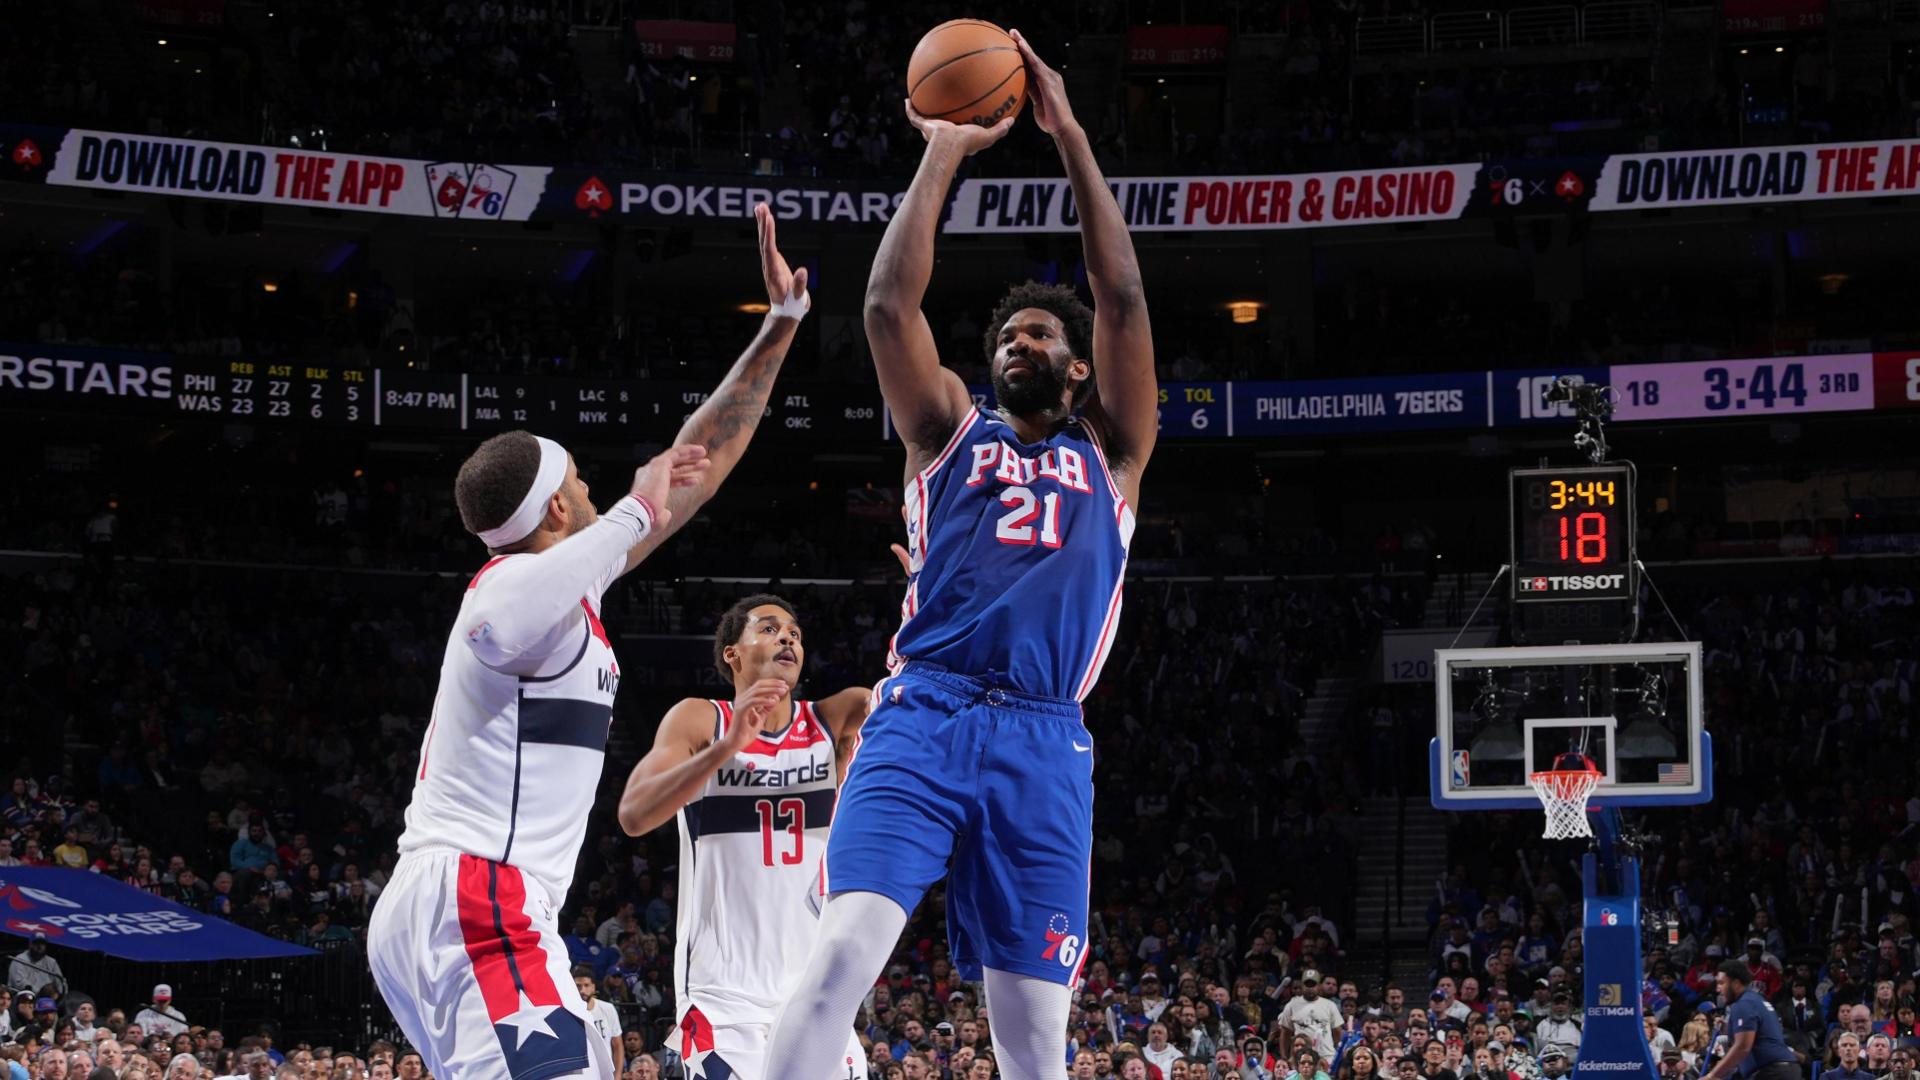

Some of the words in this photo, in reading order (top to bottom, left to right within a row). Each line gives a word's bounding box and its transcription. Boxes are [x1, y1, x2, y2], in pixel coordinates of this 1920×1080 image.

[76, 136, 266, 195] DOWNLOAD
[275, 153, 335, 201] THE
[337, 160, 404, 207] APP
[1617, 150, 1807, 204] DOWNLOAD
[1817, 146, 1878, 193] THE
[467, 184, 503, 216] 76
[976, 184, 1057, 227] PLAY
[1184, 180, 1293, 225] POKER
[1299, 178, 1325, 222] &
[1333, 171, 1455, 220] CASINO
[230, 361, 254, 375] REB
[267, 364, 293, 378] AST
[305, 367, 329, 380] BLK
[342, 370, 366, 383] STL
[184, 374, 216, 392] PHI
[231, 378, 254, 394] 27
[268, 380, 292, 396] 27
[310, 383, 323, 399] 2
[347, 386, 359, 401] 5
[475, 385, 499, 399] LAL
[515, 387, 525, 399] 9
[579, 389, 606, 402] LAC
[619, 391, 629, 402] 8
[1184, 387, 1216, 403] TOL
[1627, 380, 1660, 407] 18
[1704, 364, 1807, 411] 3:44
[1820, 373, 1860, 394] 3RD
[177, 394, 222, 412] WAS
[230, 398, 254, 414] 23
[268, 400, 292, 416] 23
[310, 403, 323, 419] 6
[347, 405, 359, 421] 3
[385, 389, 423, 407] 8:47
[426, 391, 456, 409] PM
[784, 395, 810, 408] ATL
[1256, 392, 1387, 421] PHILADELPHIA
[1394, 389, 1464, 415] 76ERS
[475, 407, 500, 420] MIA
[513, 409, 527, 421] 12
[579, 411, 608, 424] NYK
[618, 413, 628, 425] 4
[784, 416, 813, 429] OKC
[844, 407, 875, 419] 8:00
[1191, 408, 1209, 430] 6
[966, 440, 1094, 496] PHILA
[1550, 481, 1615, 510] 3:44
[996, 485, 1062, 549] 21
[1560, 512, 1607, 563] 18
[1548, 574, 1624, 590] TISSOT
[1391, 660, 1429, 679] 120
[717, 754, 830, 788] wizards
[755, 797, 805, 868] 13
[40, 910, 191, 928] POKER
[67, 919, 204, 939] STARS
[1041, 928, 1079, 968] 76
[1588, 1006, 1635, 1017] BETMGM
[1577, 1060, 1644, 1072] ticketmaster
